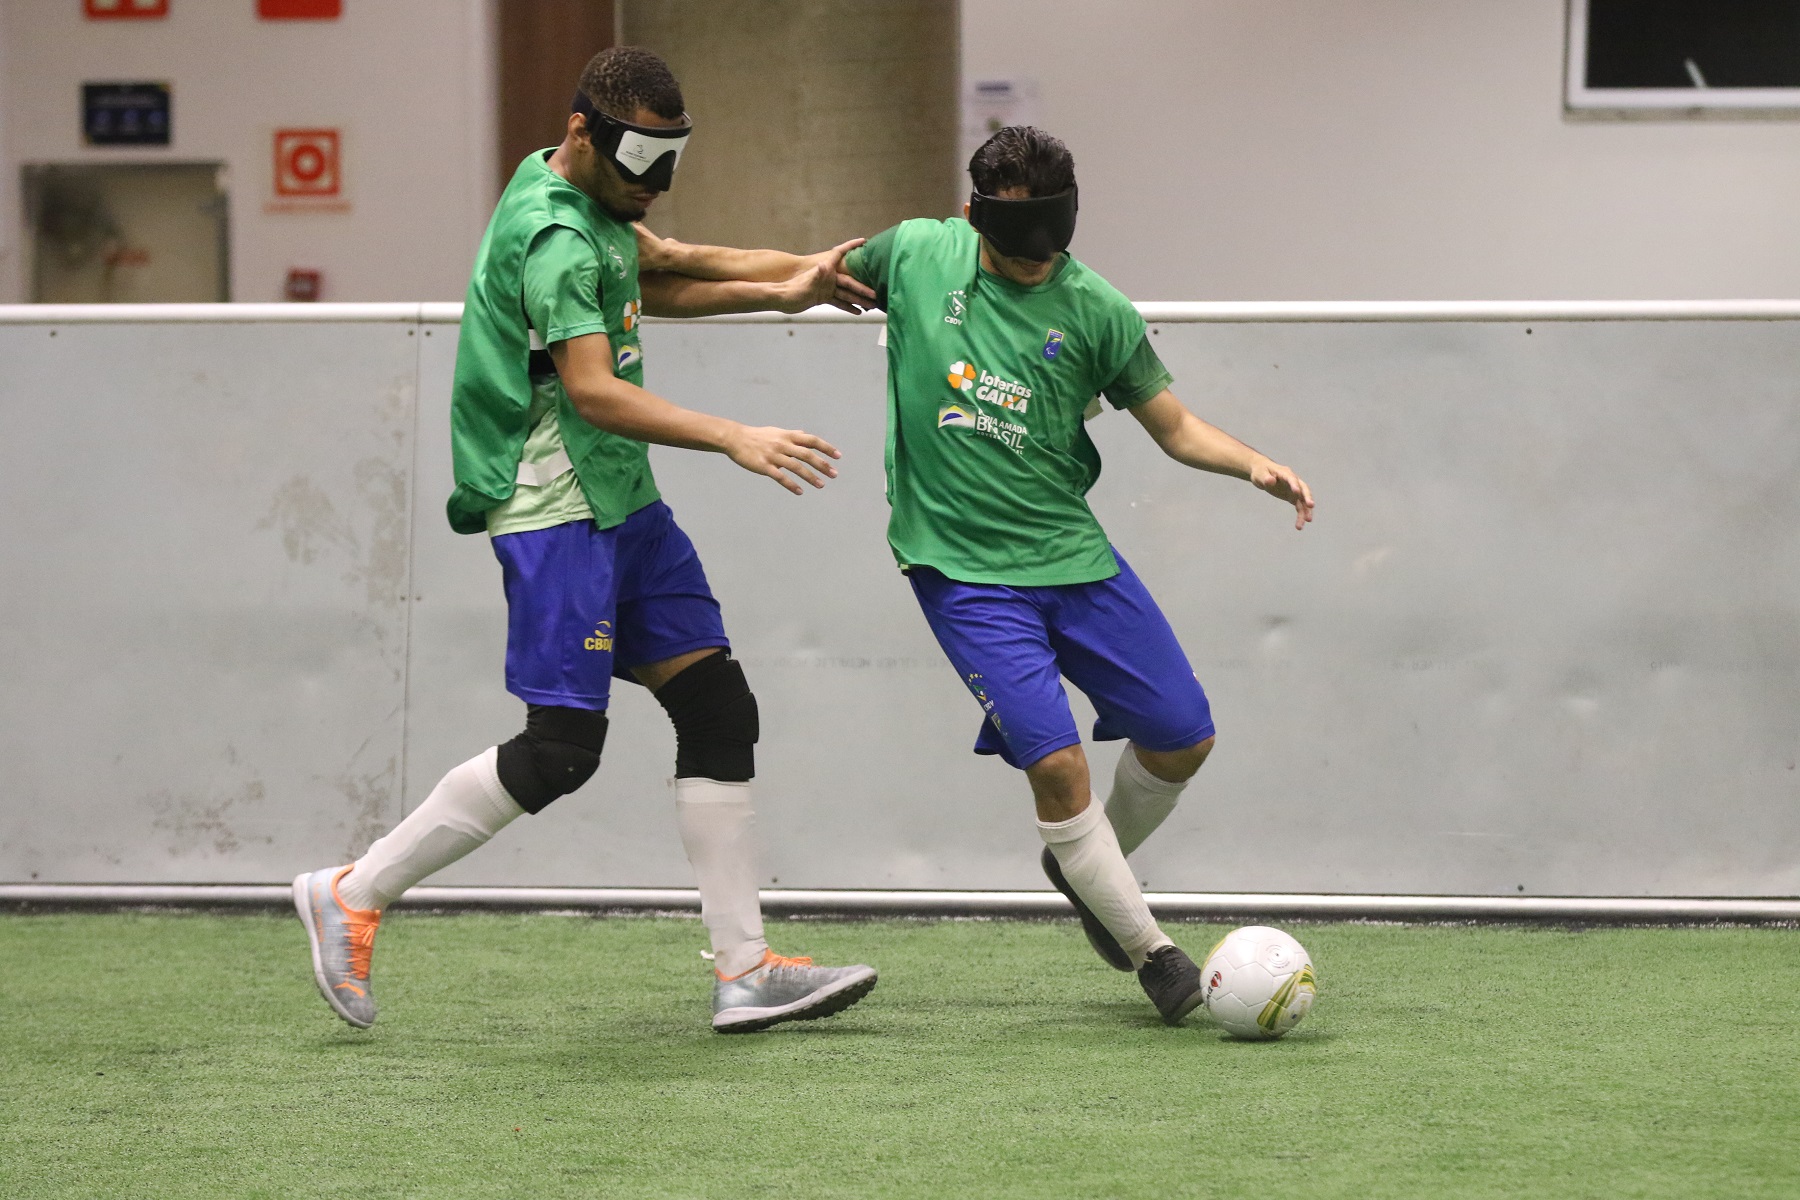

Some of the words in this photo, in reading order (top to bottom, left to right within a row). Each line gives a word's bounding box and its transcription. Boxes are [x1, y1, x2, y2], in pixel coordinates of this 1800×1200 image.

[979, 369, 1032, 398] loterias
[975, 385, 1028, 414] CAIXA
[998, 421, 1028, 435] AMADA
